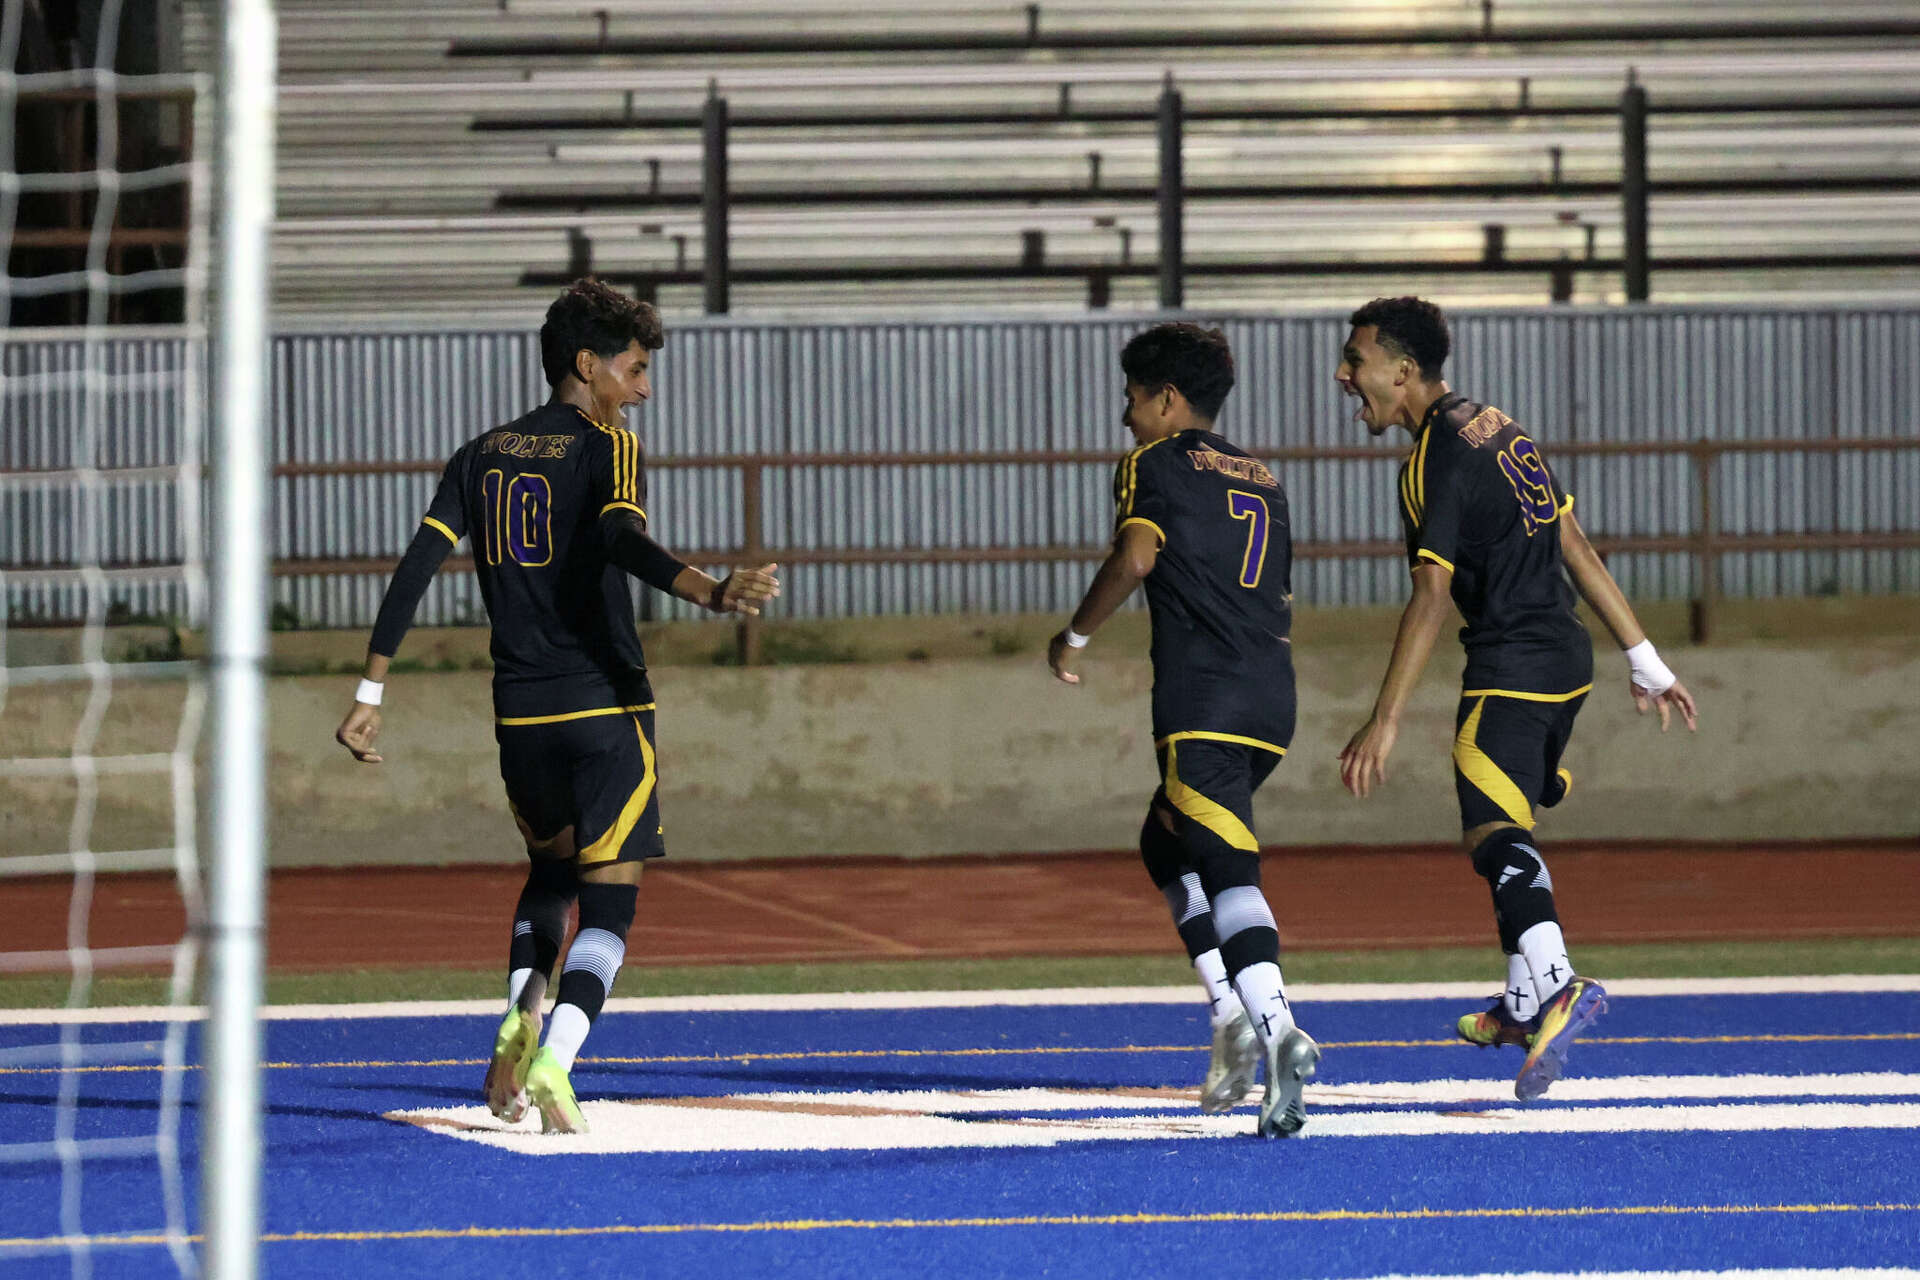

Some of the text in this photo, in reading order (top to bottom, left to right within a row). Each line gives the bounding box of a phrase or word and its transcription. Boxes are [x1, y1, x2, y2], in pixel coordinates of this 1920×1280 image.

[482, 468, 553, 567] 10
[1497, 435, 1559, 537] 19
[1227, 488, 1270, 589] 7
